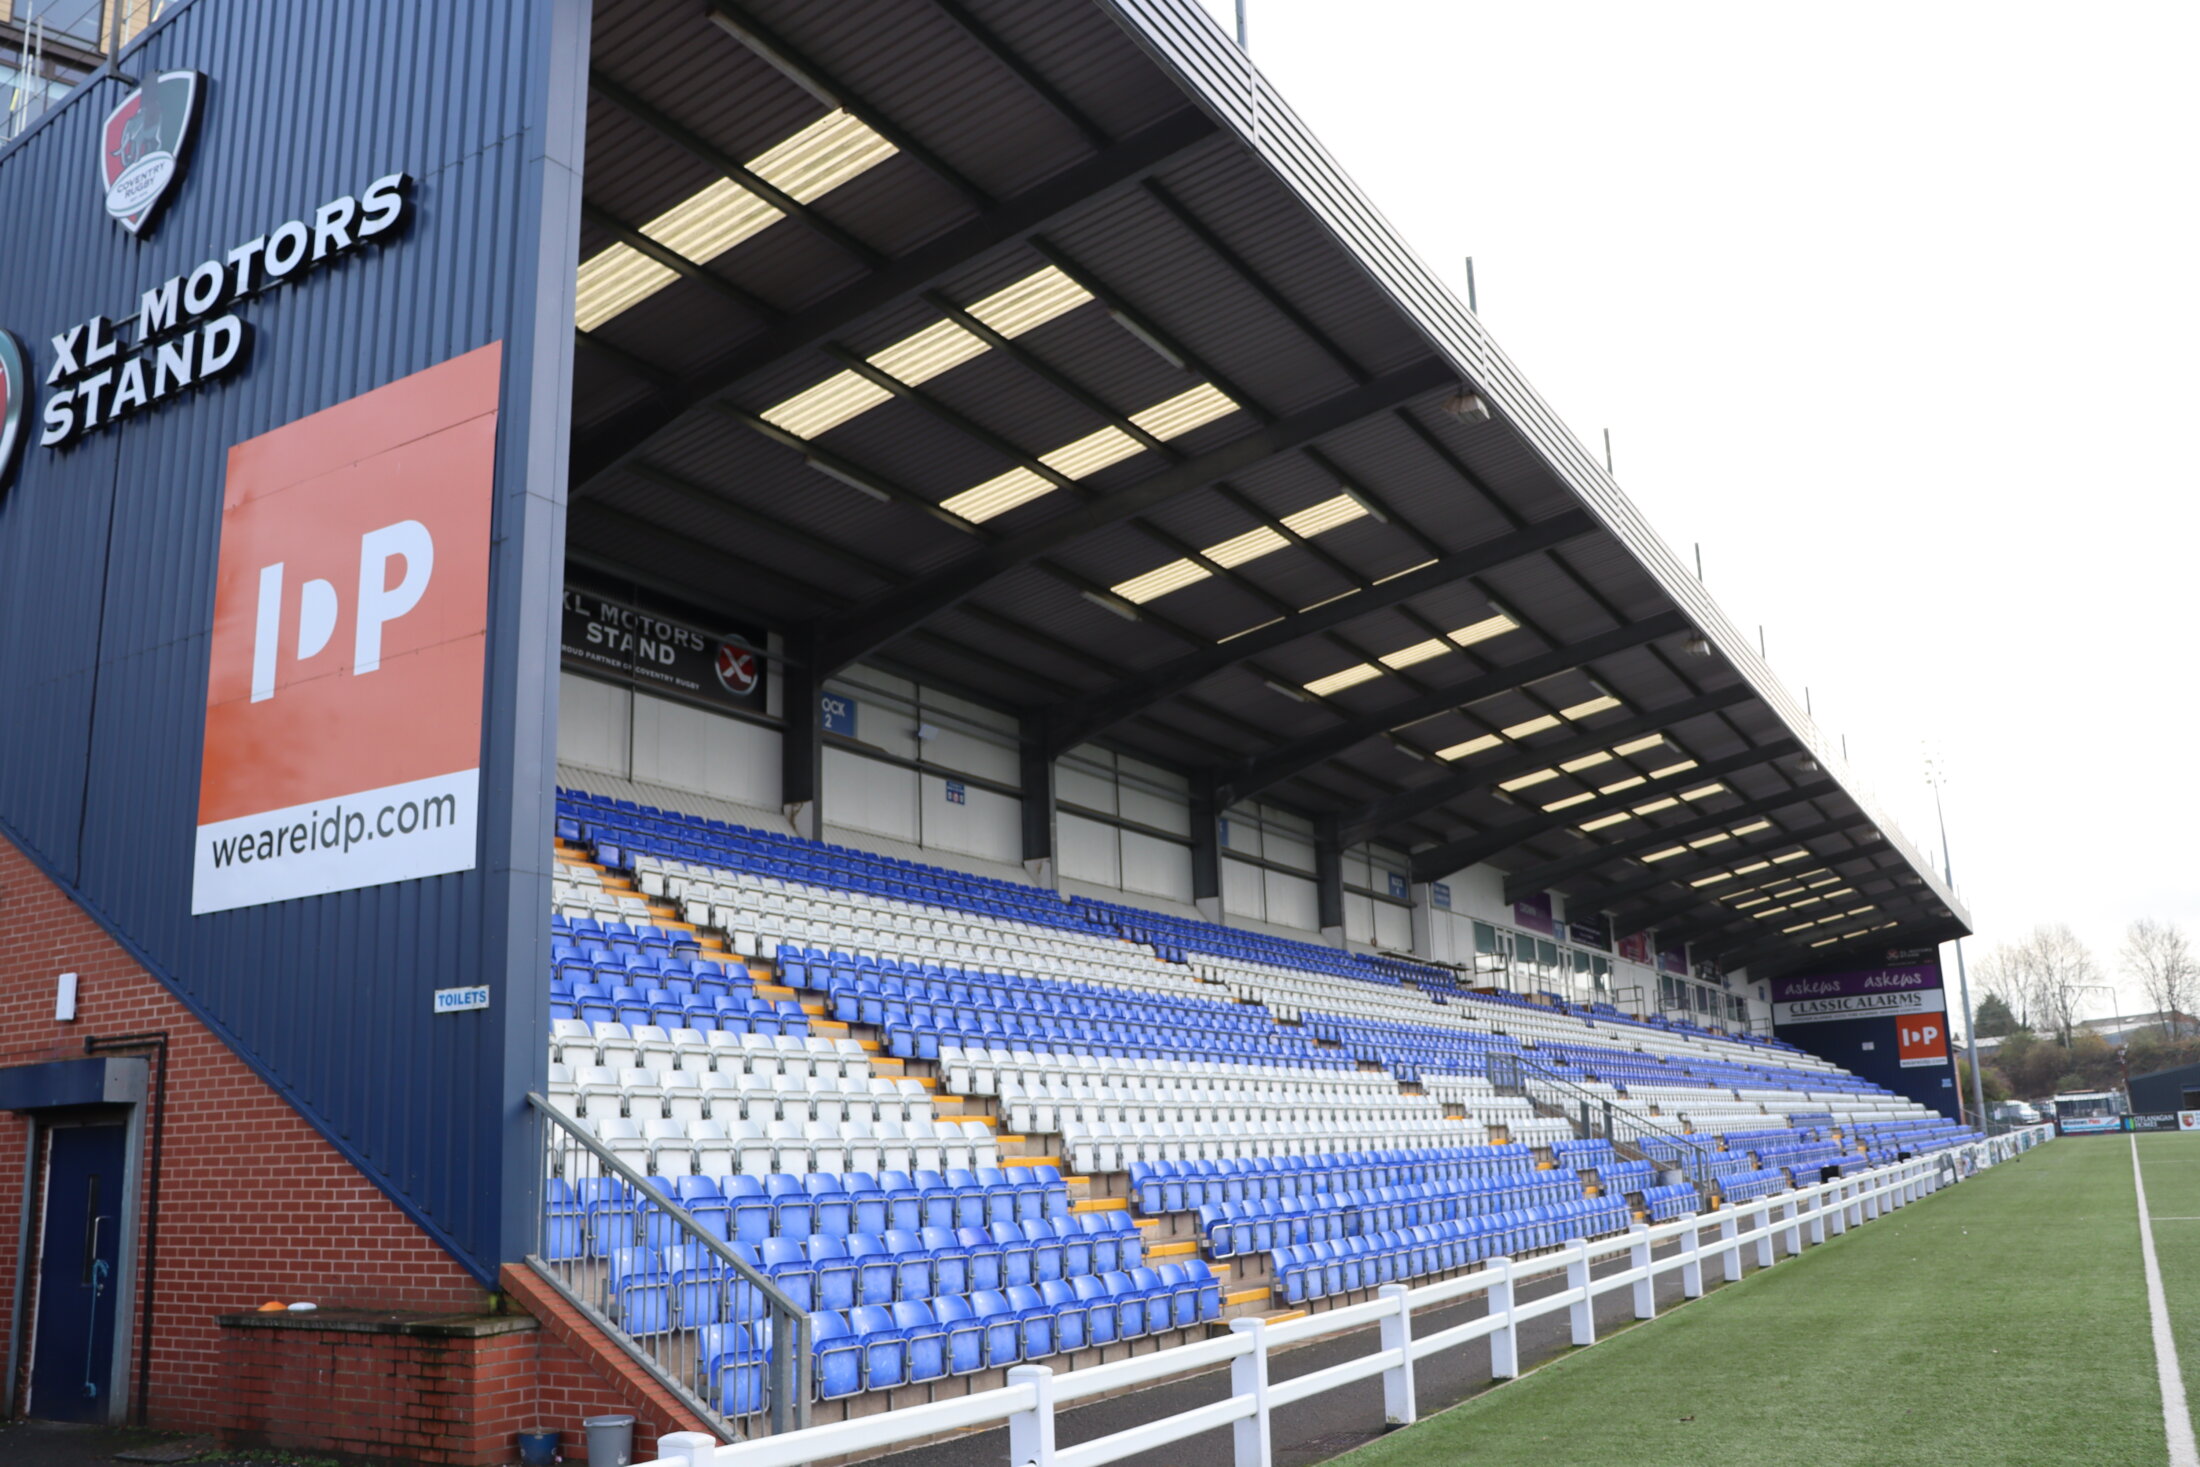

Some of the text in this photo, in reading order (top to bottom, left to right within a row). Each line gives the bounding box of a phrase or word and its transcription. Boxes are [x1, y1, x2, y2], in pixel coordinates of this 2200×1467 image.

[116, 161, 166, 194] COVENTRY
[125, 176, 156, 198] RUGBY
[46, 171, 406, 387] XL MOTORS
[39, 314, 242, 447] STAND
[586, 621, 676, 665] STAND
[601, 602, 705, 651] MOTORS
[562, 644, 584, 657] ROUD
[585, 651, 622, 668] PARTNER
[635, 665, 674, 683] COVENTRY
[675, 677, 700, 691] RUGBY
[822, 697, 846, 718] OCK
[824, 713, 832, 728] 2
[212, 792, 457, 869] weareidp.com
[438, 990, 487, 1007] TOILETS
[1785, 971, 1922, 996] askews askews
[1789, 992, 1922, 1014] CLASSIC ALARMS
